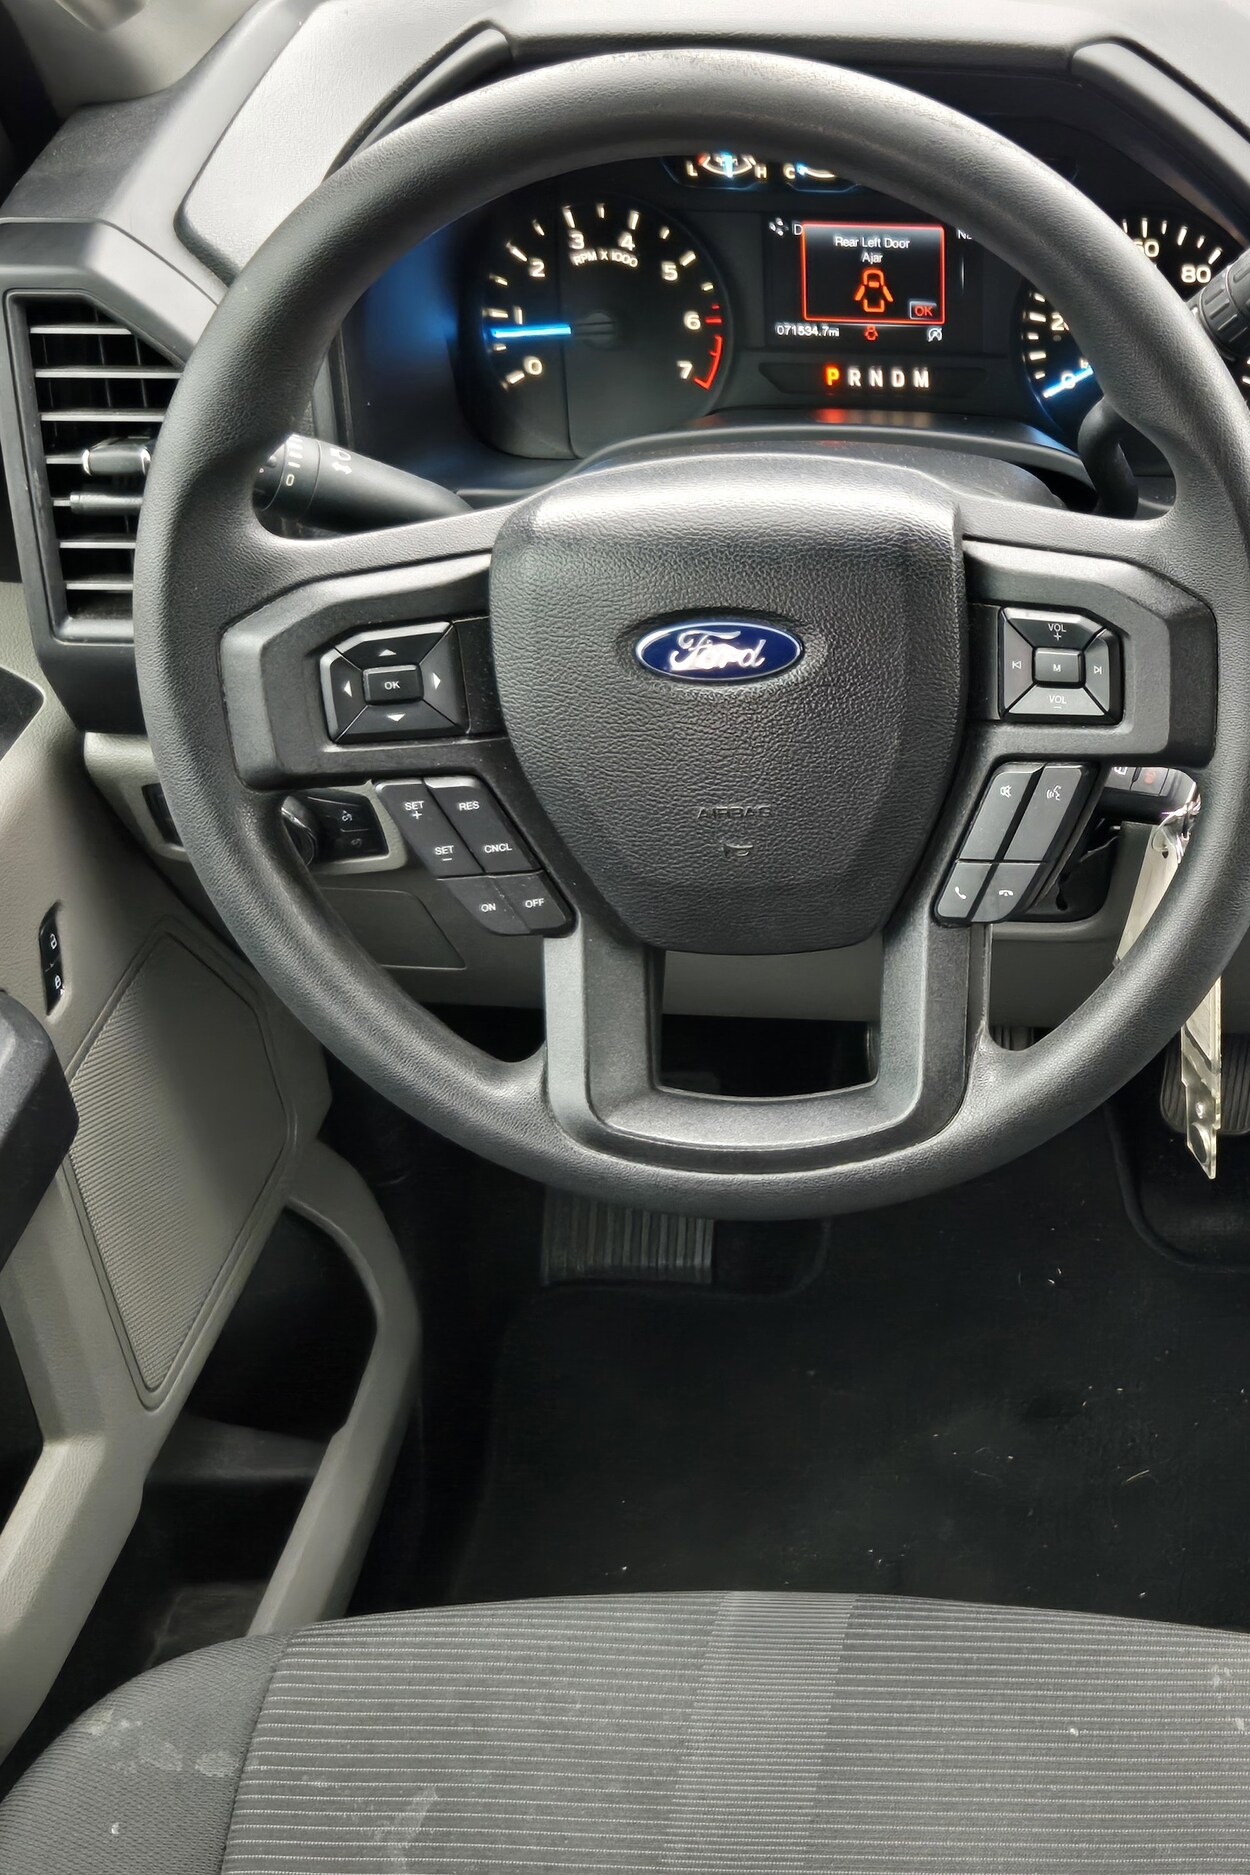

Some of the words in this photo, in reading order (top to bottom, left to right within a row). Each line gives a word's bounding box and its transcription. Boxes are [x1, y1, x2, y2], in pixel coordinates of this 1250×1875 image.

[754, 163, 767, 179] H
[784, 162, 796, 179] C
[569, 230, 585, 250] 3
[619, 232, 636, 251] 4
[834, 236, 859, 248] Rear
[861, 237, 882, 249] Left
[884, 239, 910, 249] Door
[572, 250, 598, 266] RPM
[861, 252, 884, 263] Ajar
[529, 258, 546, 278] 2
[660, 260, 678, 281] 5
[1181, 265, 1211, 284] 80
[914, 306, 933, 316] OK
[683, 311, 701, 331] 6
[523, 355, 543, 377] 0
[677, 360, 693, 379] 7
[826, 367, 840, 386] P
[849, 369, 862, 387] R
[870, 369, 884, 387] N
[892, 370, 905, 388] D
[913, 370, 930, 389] M
[1047, 623, 1067, 633] VOL
[669, 629, 766, 671] Ford
[384, 681, 401, 691] OK
[1048, 694, 1068, 704] VOL
[403, 800, 425, 811] SET
[458, 800, 481, 812] RES
[697, 805, 772, 819] AIRBAG
[434, 844, 456, 856] SET
[484, 843, 513, 854] CNCL
[480, 903, 496, 913] ON
[524, 898, 545, 910] OFF
